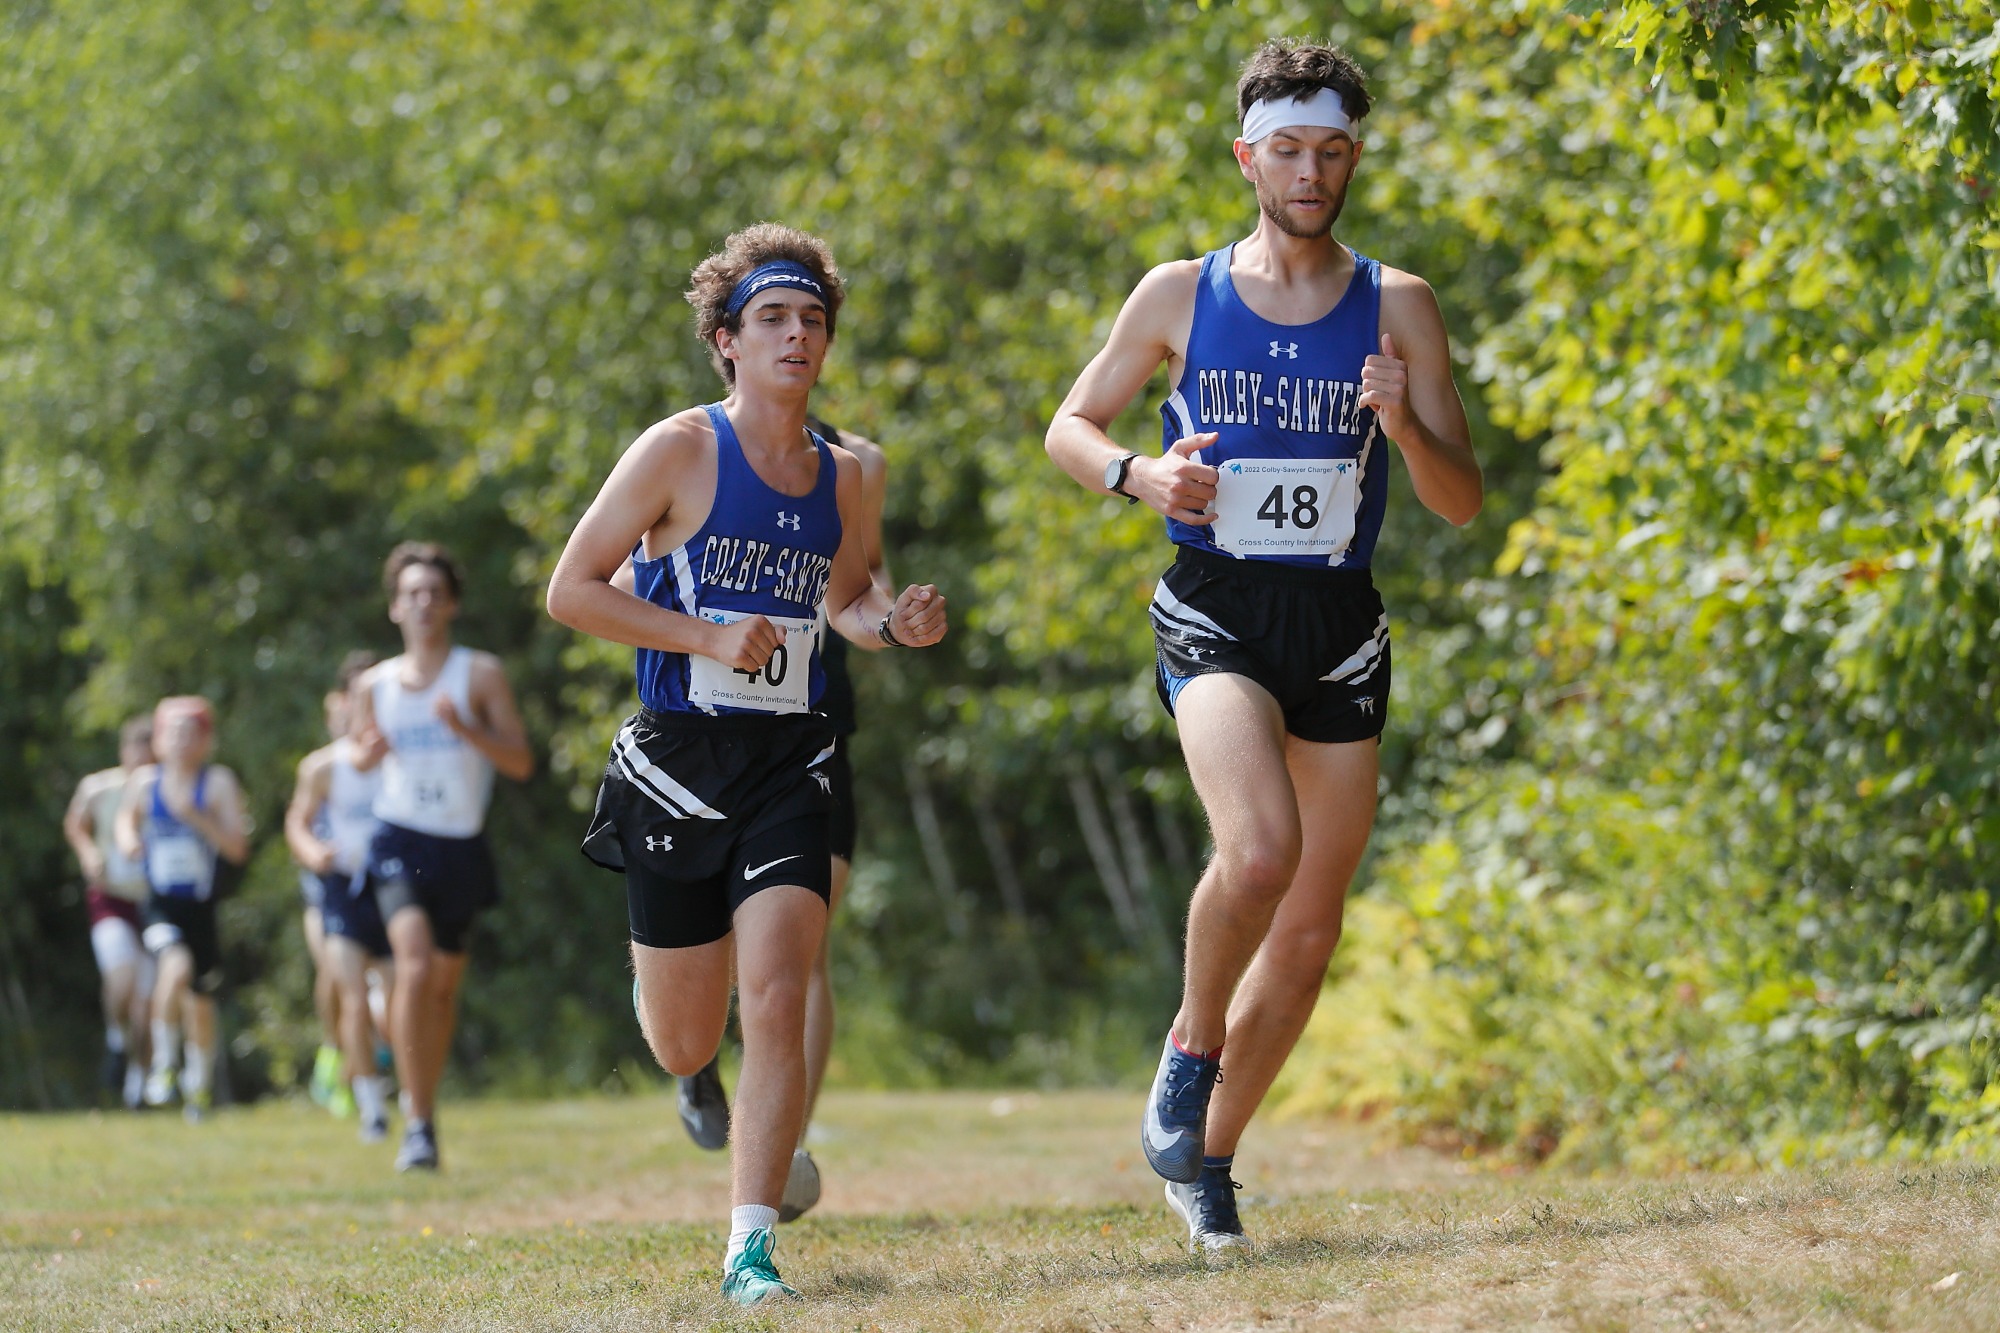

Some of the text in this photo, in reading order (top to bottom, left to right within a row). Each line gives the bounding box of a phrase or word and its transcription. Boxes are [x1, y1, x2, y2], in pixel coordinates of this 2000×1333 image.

[1261, 466, 1306, 474] Colby-Sawyer
[1307, 466, 1333, 474] Charger
[1257, 484, 1319, 530] 48
[1238, 538, 1337, 548] Cross Country Invitational
[711, 689, 798, 705] Cross Country Invitational
